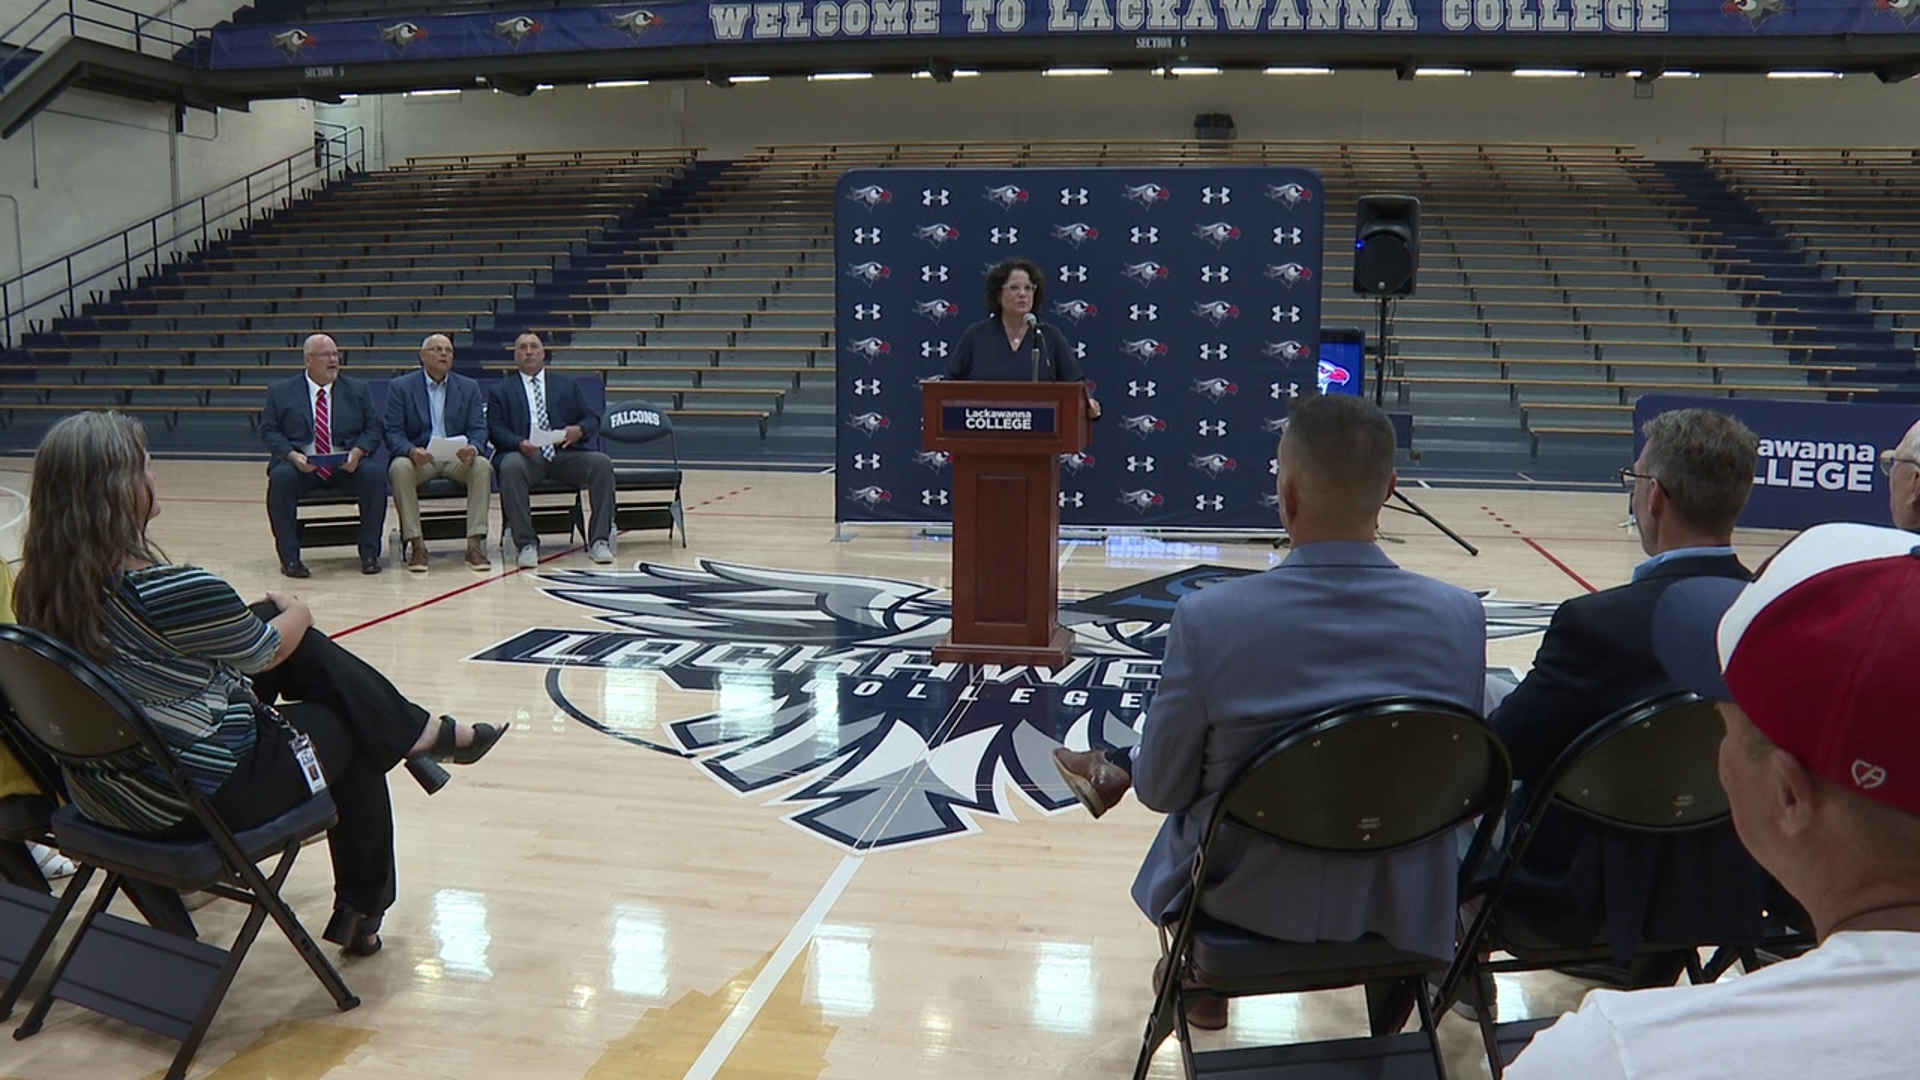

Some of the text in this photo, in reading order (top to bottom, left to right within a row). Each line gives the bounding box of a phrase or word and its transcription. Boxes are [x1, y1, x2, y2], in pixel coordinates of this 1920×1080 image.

[709, 0, 1669, 40] WELCOME TO LACKAWANNA COLLEGE
[1136, 36, 1188, 48] SECTION 6
[610, 410, 660, 428] FALCONS
[965, 408, 1032, 418] Lackawanna
[965, 418, 1032, 430] COLLEGE
[1757, 439, 1875, 462] awanna
[799, 679, 1144, 709] COLLEGE
